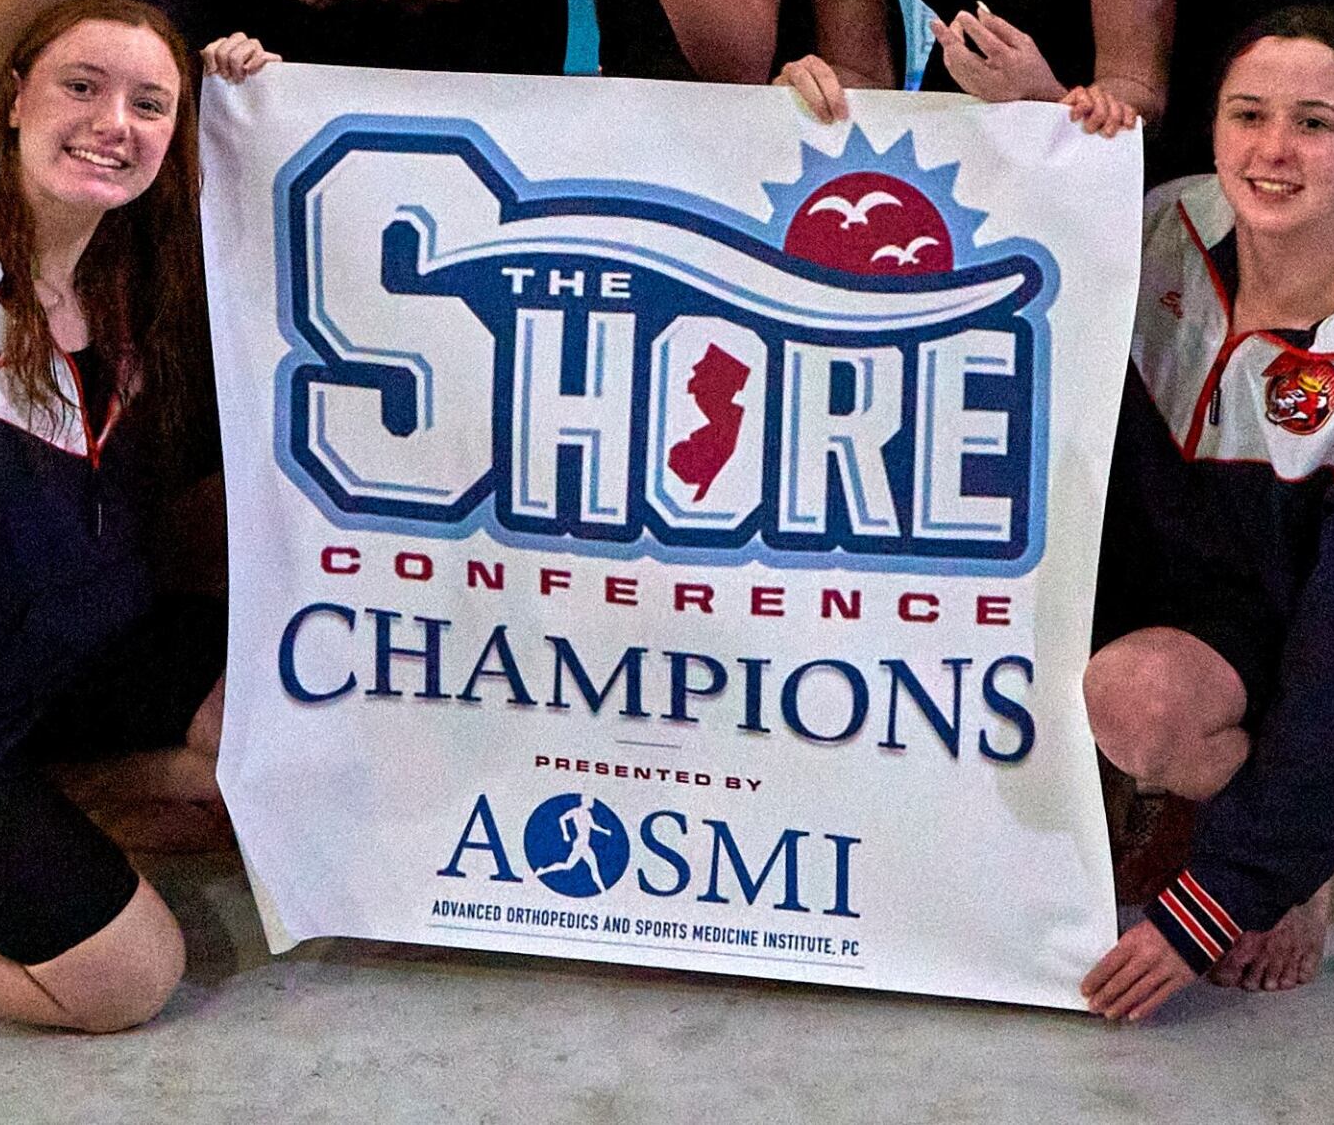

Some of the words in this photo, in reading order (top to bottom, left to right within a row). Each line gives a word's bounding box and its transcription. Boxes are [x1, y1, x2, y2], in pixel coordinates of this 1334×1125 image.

[501, 265, 634, 300] THE
[304, 148, 1020, 543] SHORE
[319, 543, 1015, 628] CONFERENCE
[276, 602, 1037, 767] CHAMPIONS
[533, 754, 713, 790] PRESENTED
[725, 776, 764, 793] BY
[431, 900, 503, 923] ADVANCED
[506, 906, 599, 932] ORTHOPEDICS
[602, 915, 632, 935] AND
[634, 919, 689, 941] SPORTS
[692, 925, 760, 948] MEDICINE
[762, 931, 838, 957] INSTITUTE,
[841, 939, 861, 958] PC
